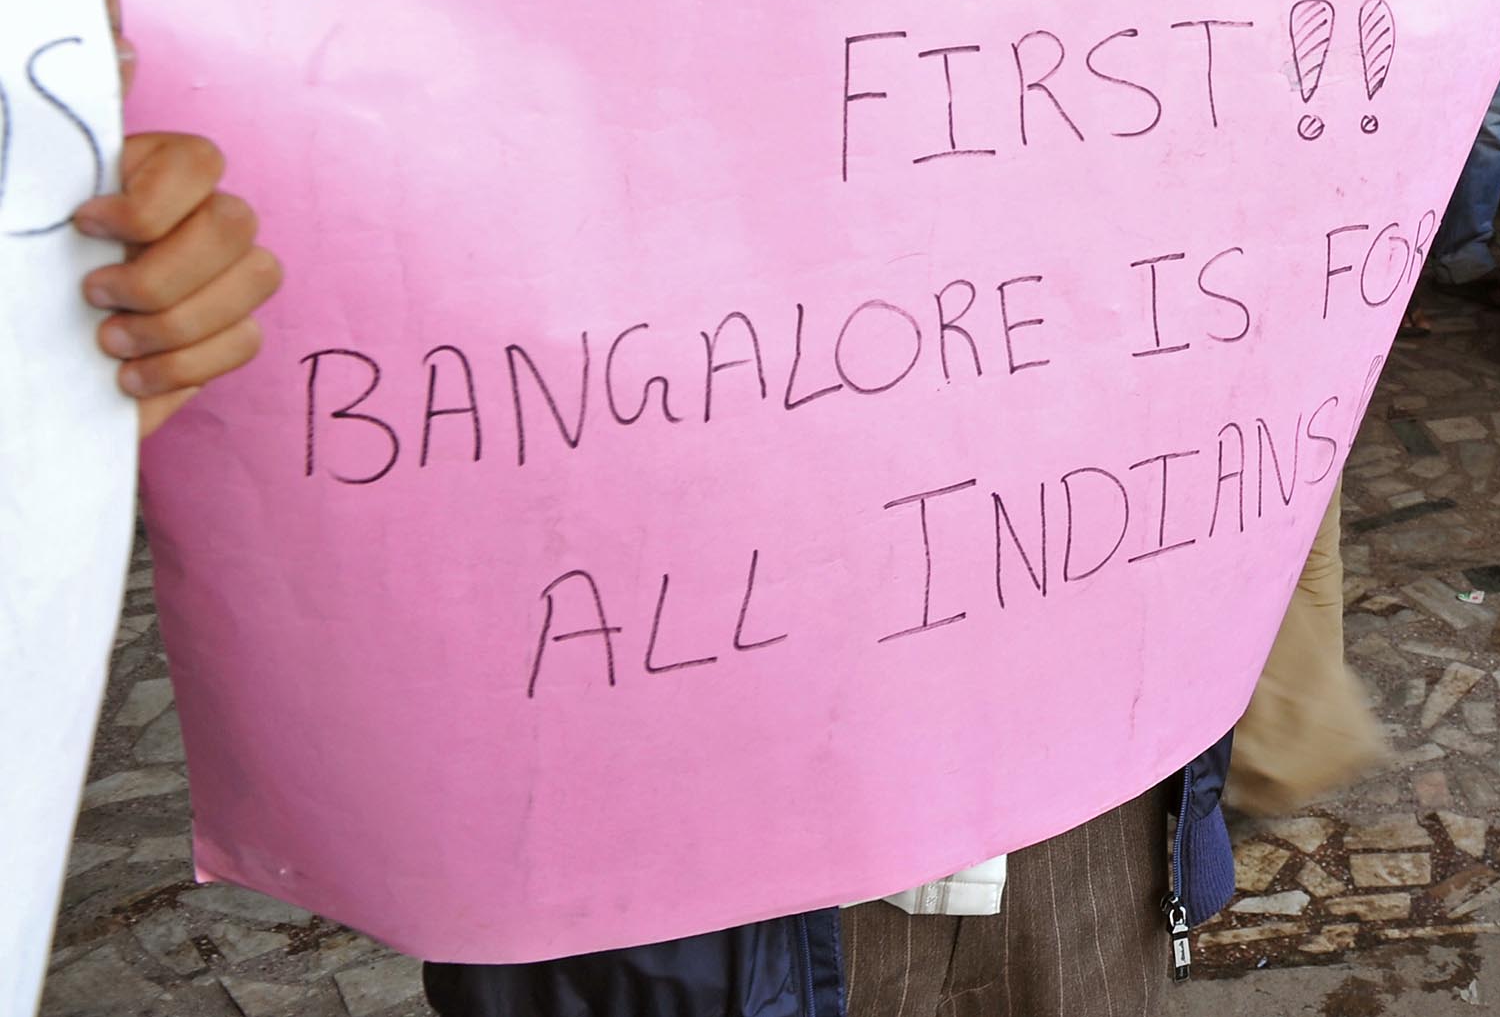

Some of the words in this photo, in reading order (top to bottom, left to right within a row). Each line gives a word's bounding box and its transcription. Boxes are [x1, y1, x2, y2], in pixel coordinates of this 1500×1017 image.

[300, 275, 1050, 493] BANGALORE
[1130, 247, 1250, 357] IS
[1323, 209, 1437, 321] FOR
[526, 549, 789, 699] ALL
